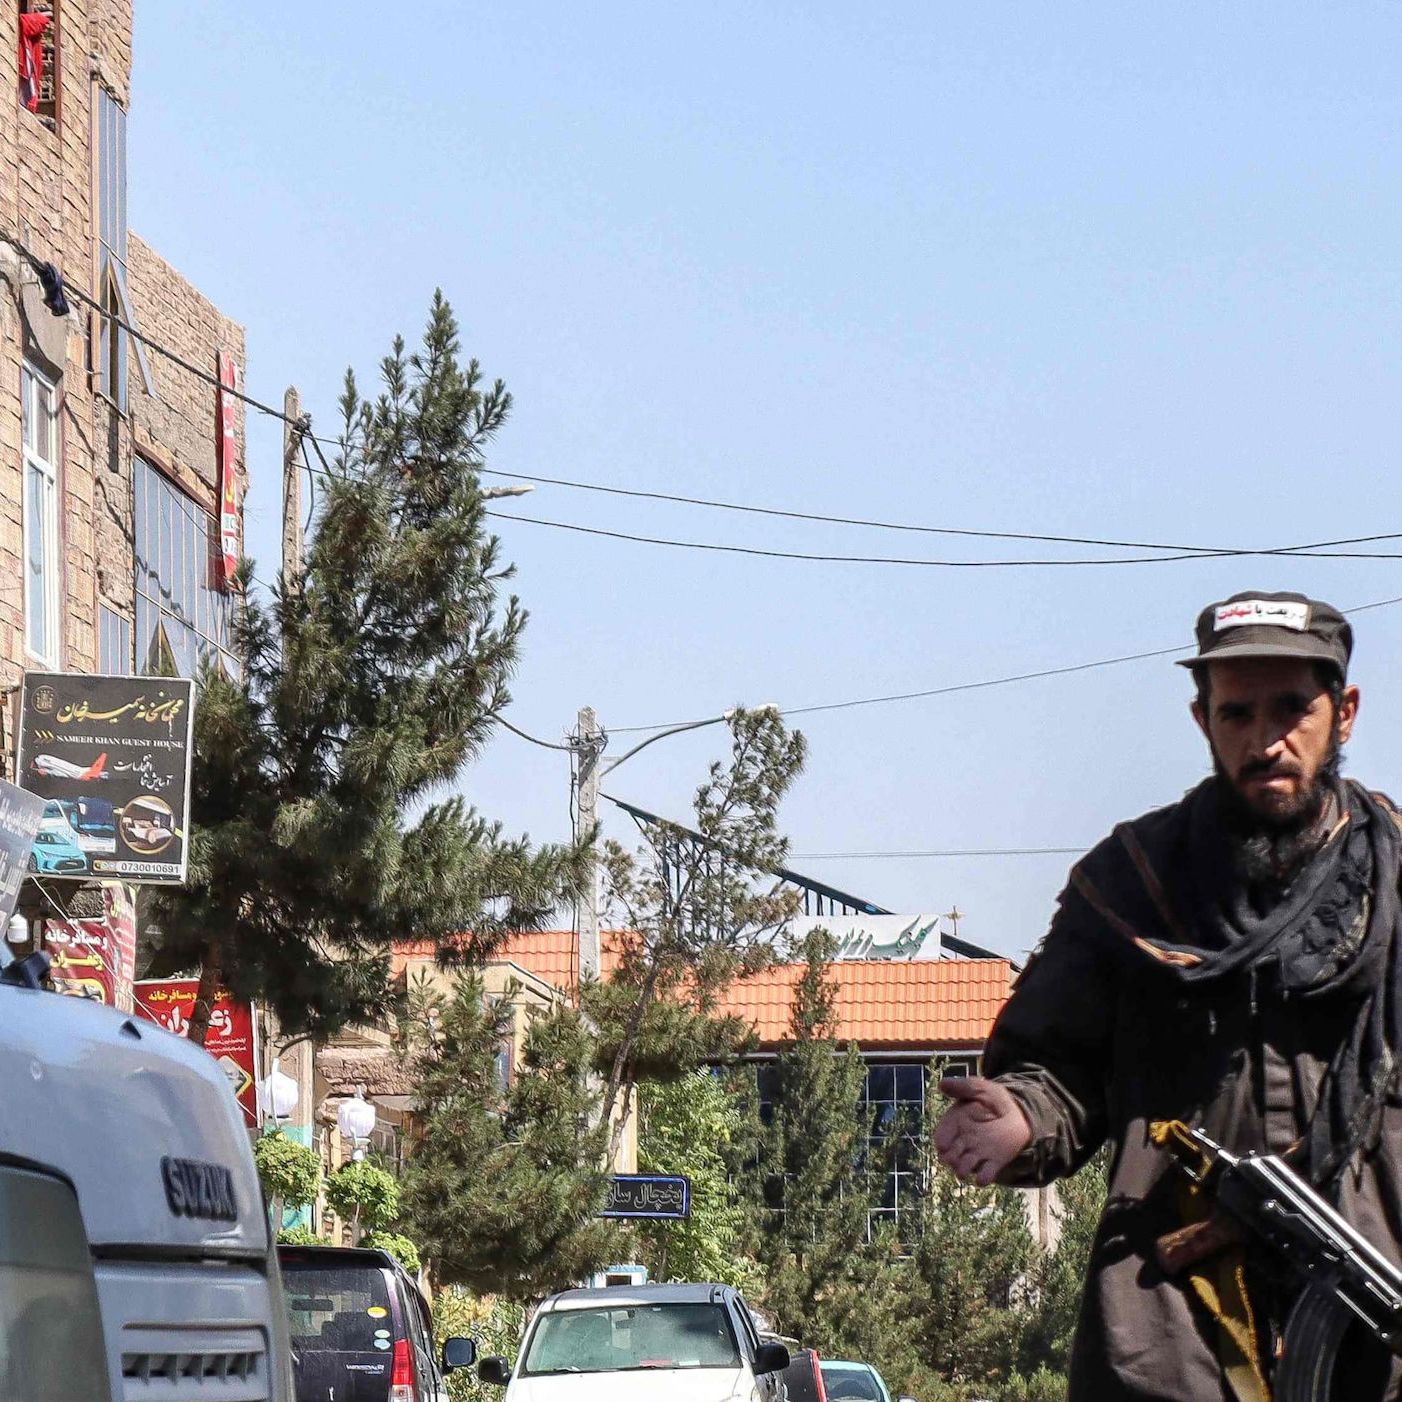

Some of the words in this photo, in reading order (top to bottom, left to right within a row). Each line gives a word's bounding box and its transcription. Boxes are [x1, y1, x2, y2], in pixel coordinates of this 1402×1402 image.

[56, 734, 94, 745] SAMEER
[93, 736, 121, 746] KHAN
[121, 738, 152, 748] GUEST
[152, 739, 185, 749] HOUSE
[121, 863, 180, 874] 0730010691
[633, 1182, 683, 1211] یخچال
